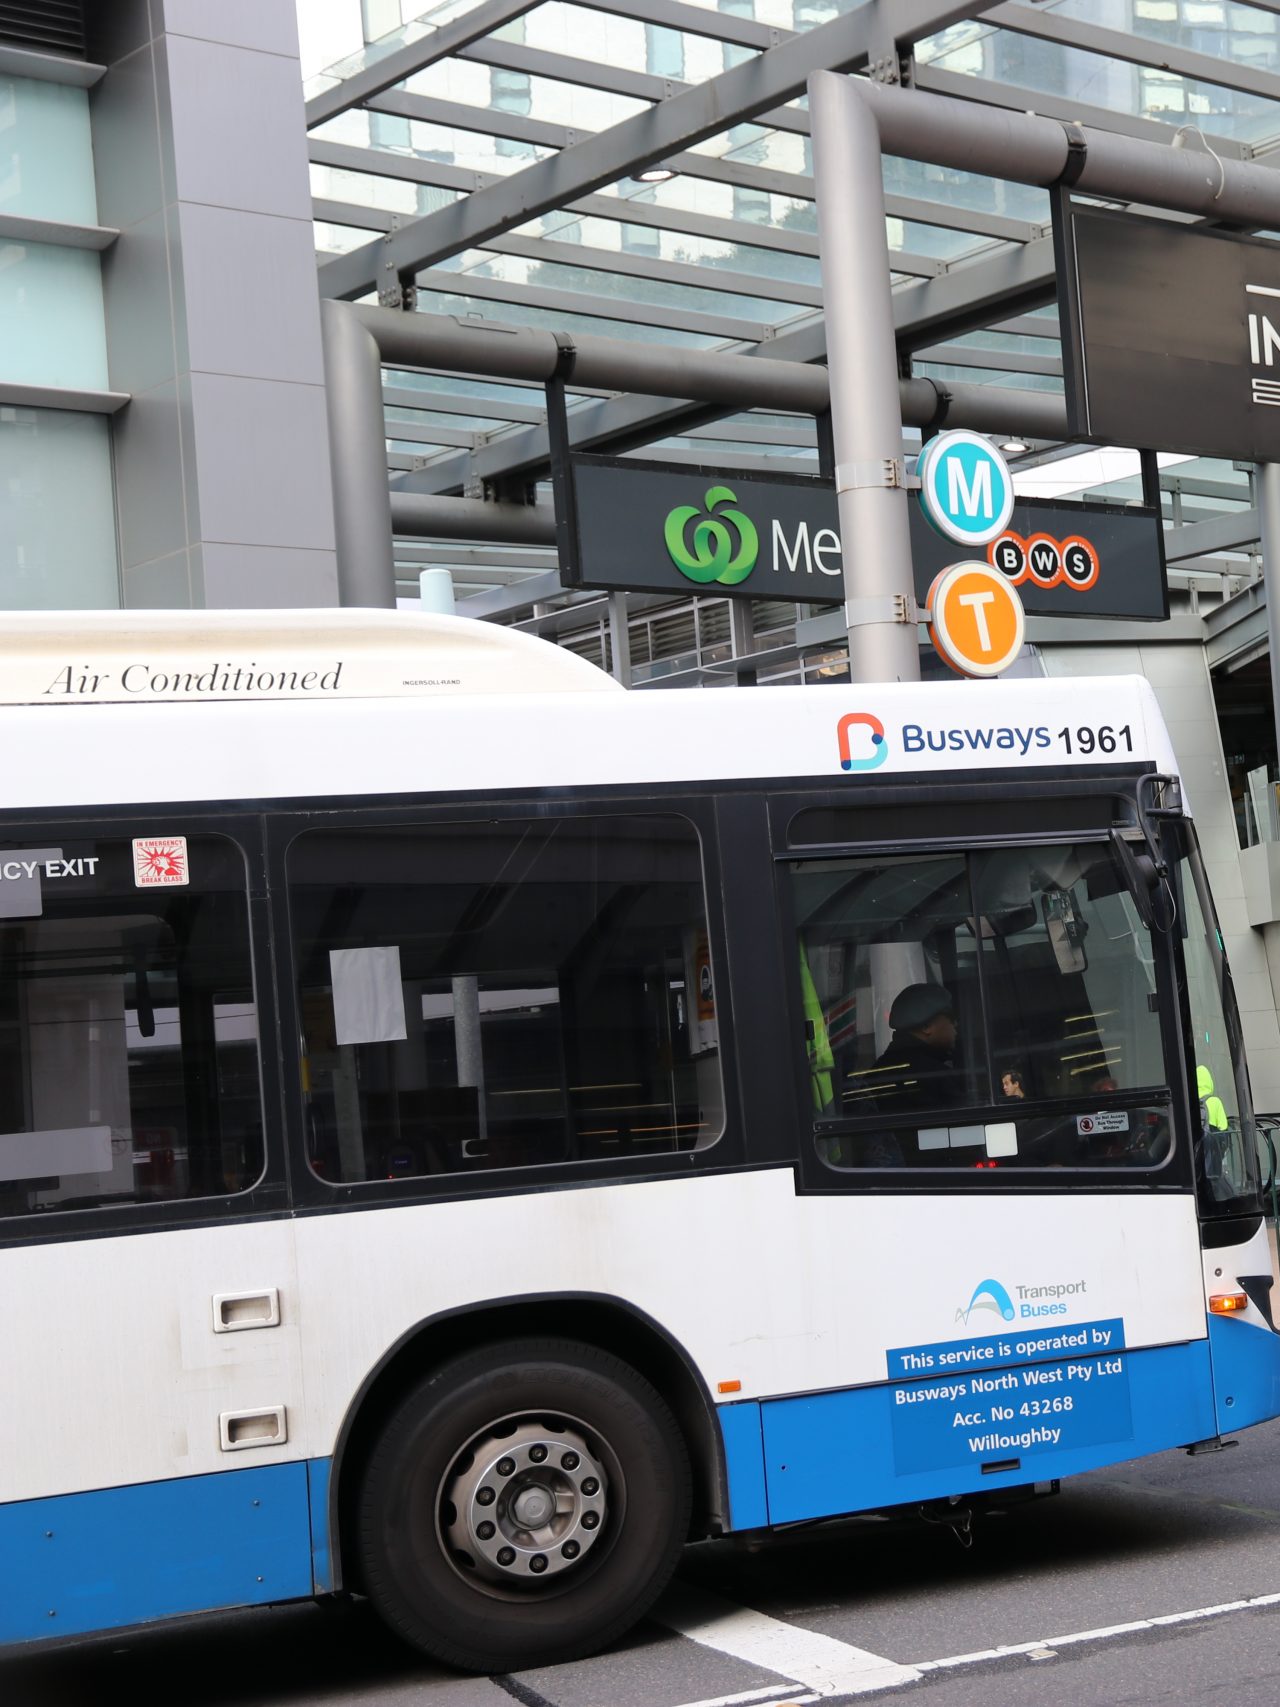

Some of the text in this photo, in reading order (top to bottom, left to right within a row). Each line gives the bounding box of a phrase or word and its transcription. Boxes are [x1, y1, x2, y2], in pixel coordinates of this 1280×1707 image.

[946, 456, 994, 519] M
[772, 519, 842, 576] Me
[958, 591, 996, 652] T
[42, 662, 344, 694] Air Conditioned
[902, 724, 1051, 756] Busways
[1057, 724, 1133, 754] 1961
[145, 839, 183, 847] EMERGENCY
[0, 857, 99, 880] CY EXIT
[141, 875, 183, 884] BREAK GLASS
[1016, 1279, 1087, 1300] Transport
[1020, 1301, 1068, 1318] Buses
[901, 1328, 1112, 1370] This service is operated by
[895, 1358, 1123, 1405] Busways North West Pty Ltd
[952, 1396, 1074, 1427] Acc. No 43268
[968, 1427, 1061, 1452] Willoughby
